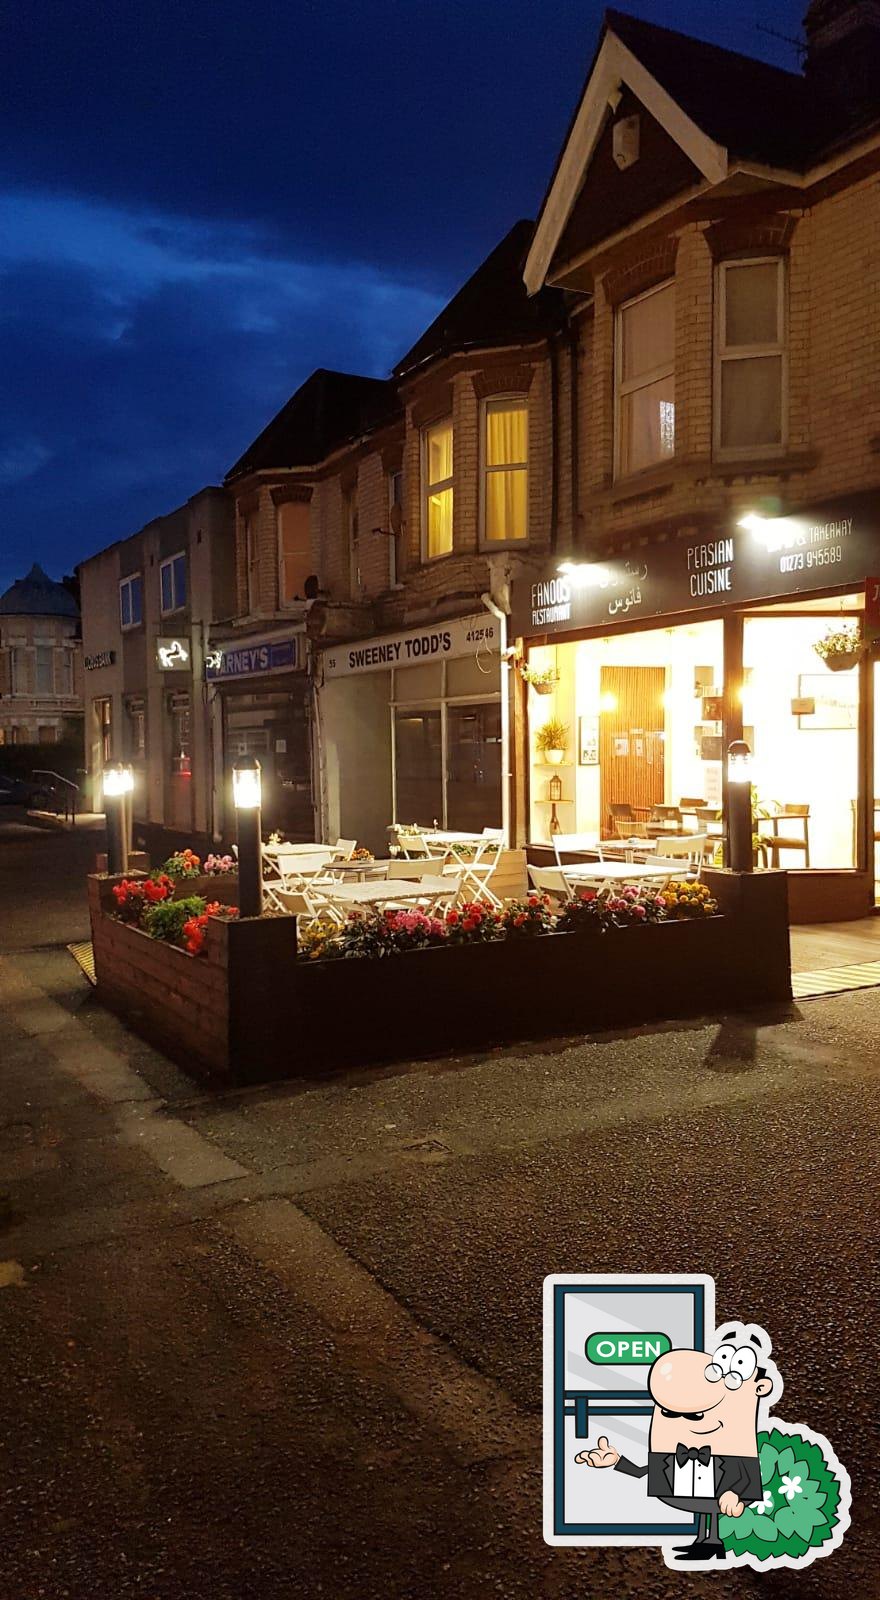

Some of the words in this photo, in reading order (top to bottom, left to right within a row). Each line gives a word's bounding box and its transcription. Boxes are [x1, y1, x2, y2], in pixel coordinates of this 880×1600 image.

[809, 520, 852, 543] TAKEAWAY
[687, 538, 734, 570] PERSIAN
[780, 553, 804, 573] 01273
[807, 546, 842, 567] 945589
[690, 567, 733, 597] CUISINE
[608, 586, 642, 614] فانوس
[349, 642, 402, 668] SWEENEY
[405, 632, 451, 658] TODD'S
